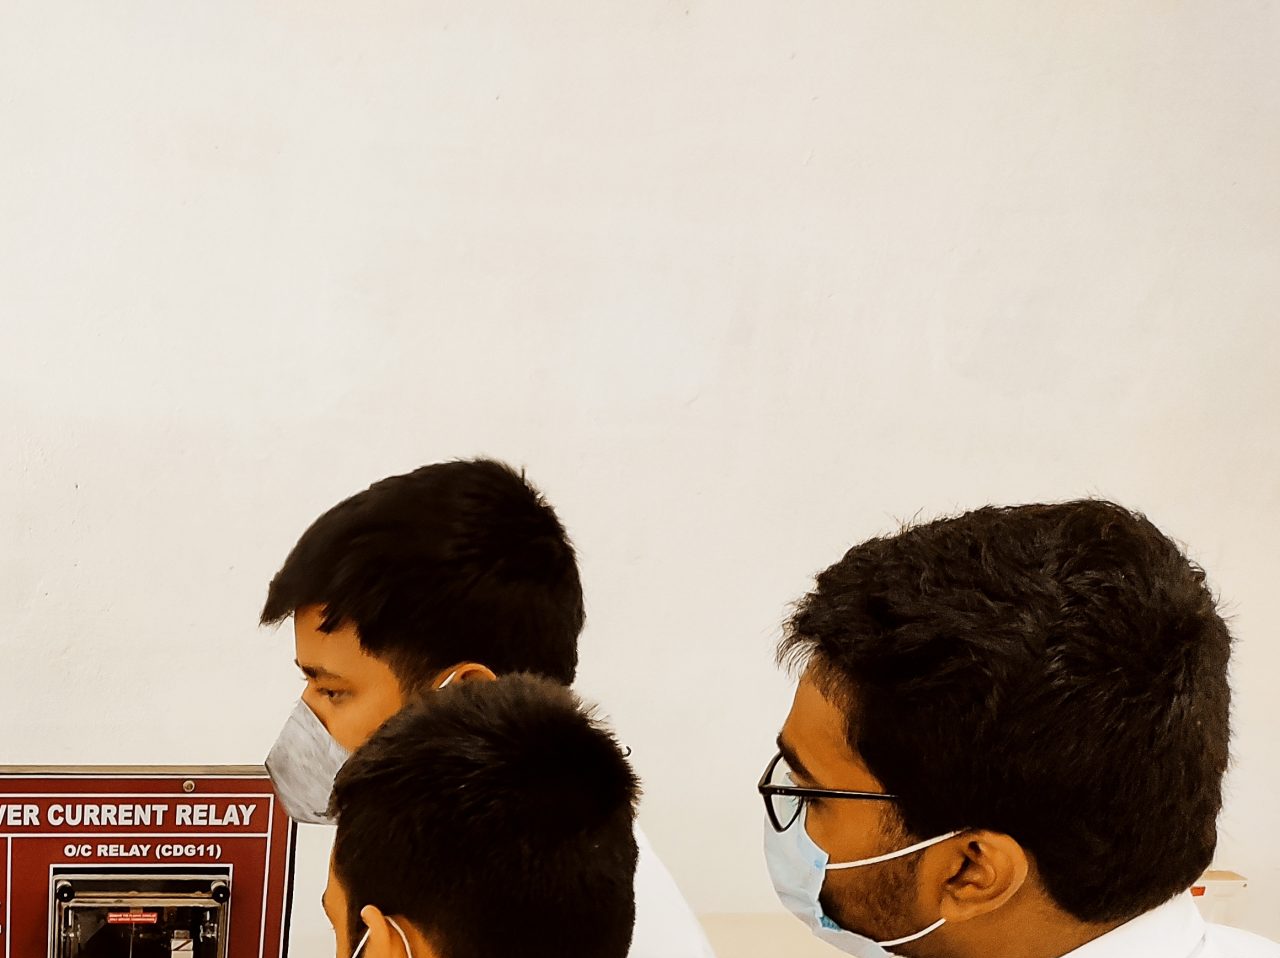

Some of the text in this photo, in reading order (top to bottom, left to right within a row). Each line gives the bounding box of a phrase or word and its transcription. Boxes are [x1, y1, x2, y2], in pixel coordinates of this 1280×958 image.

[47, 804, 168, 826] CURRENT
[175, 804, 257, 826] RELAY
[63, 844, 222, 860] O/C RELAY (CDG11)
